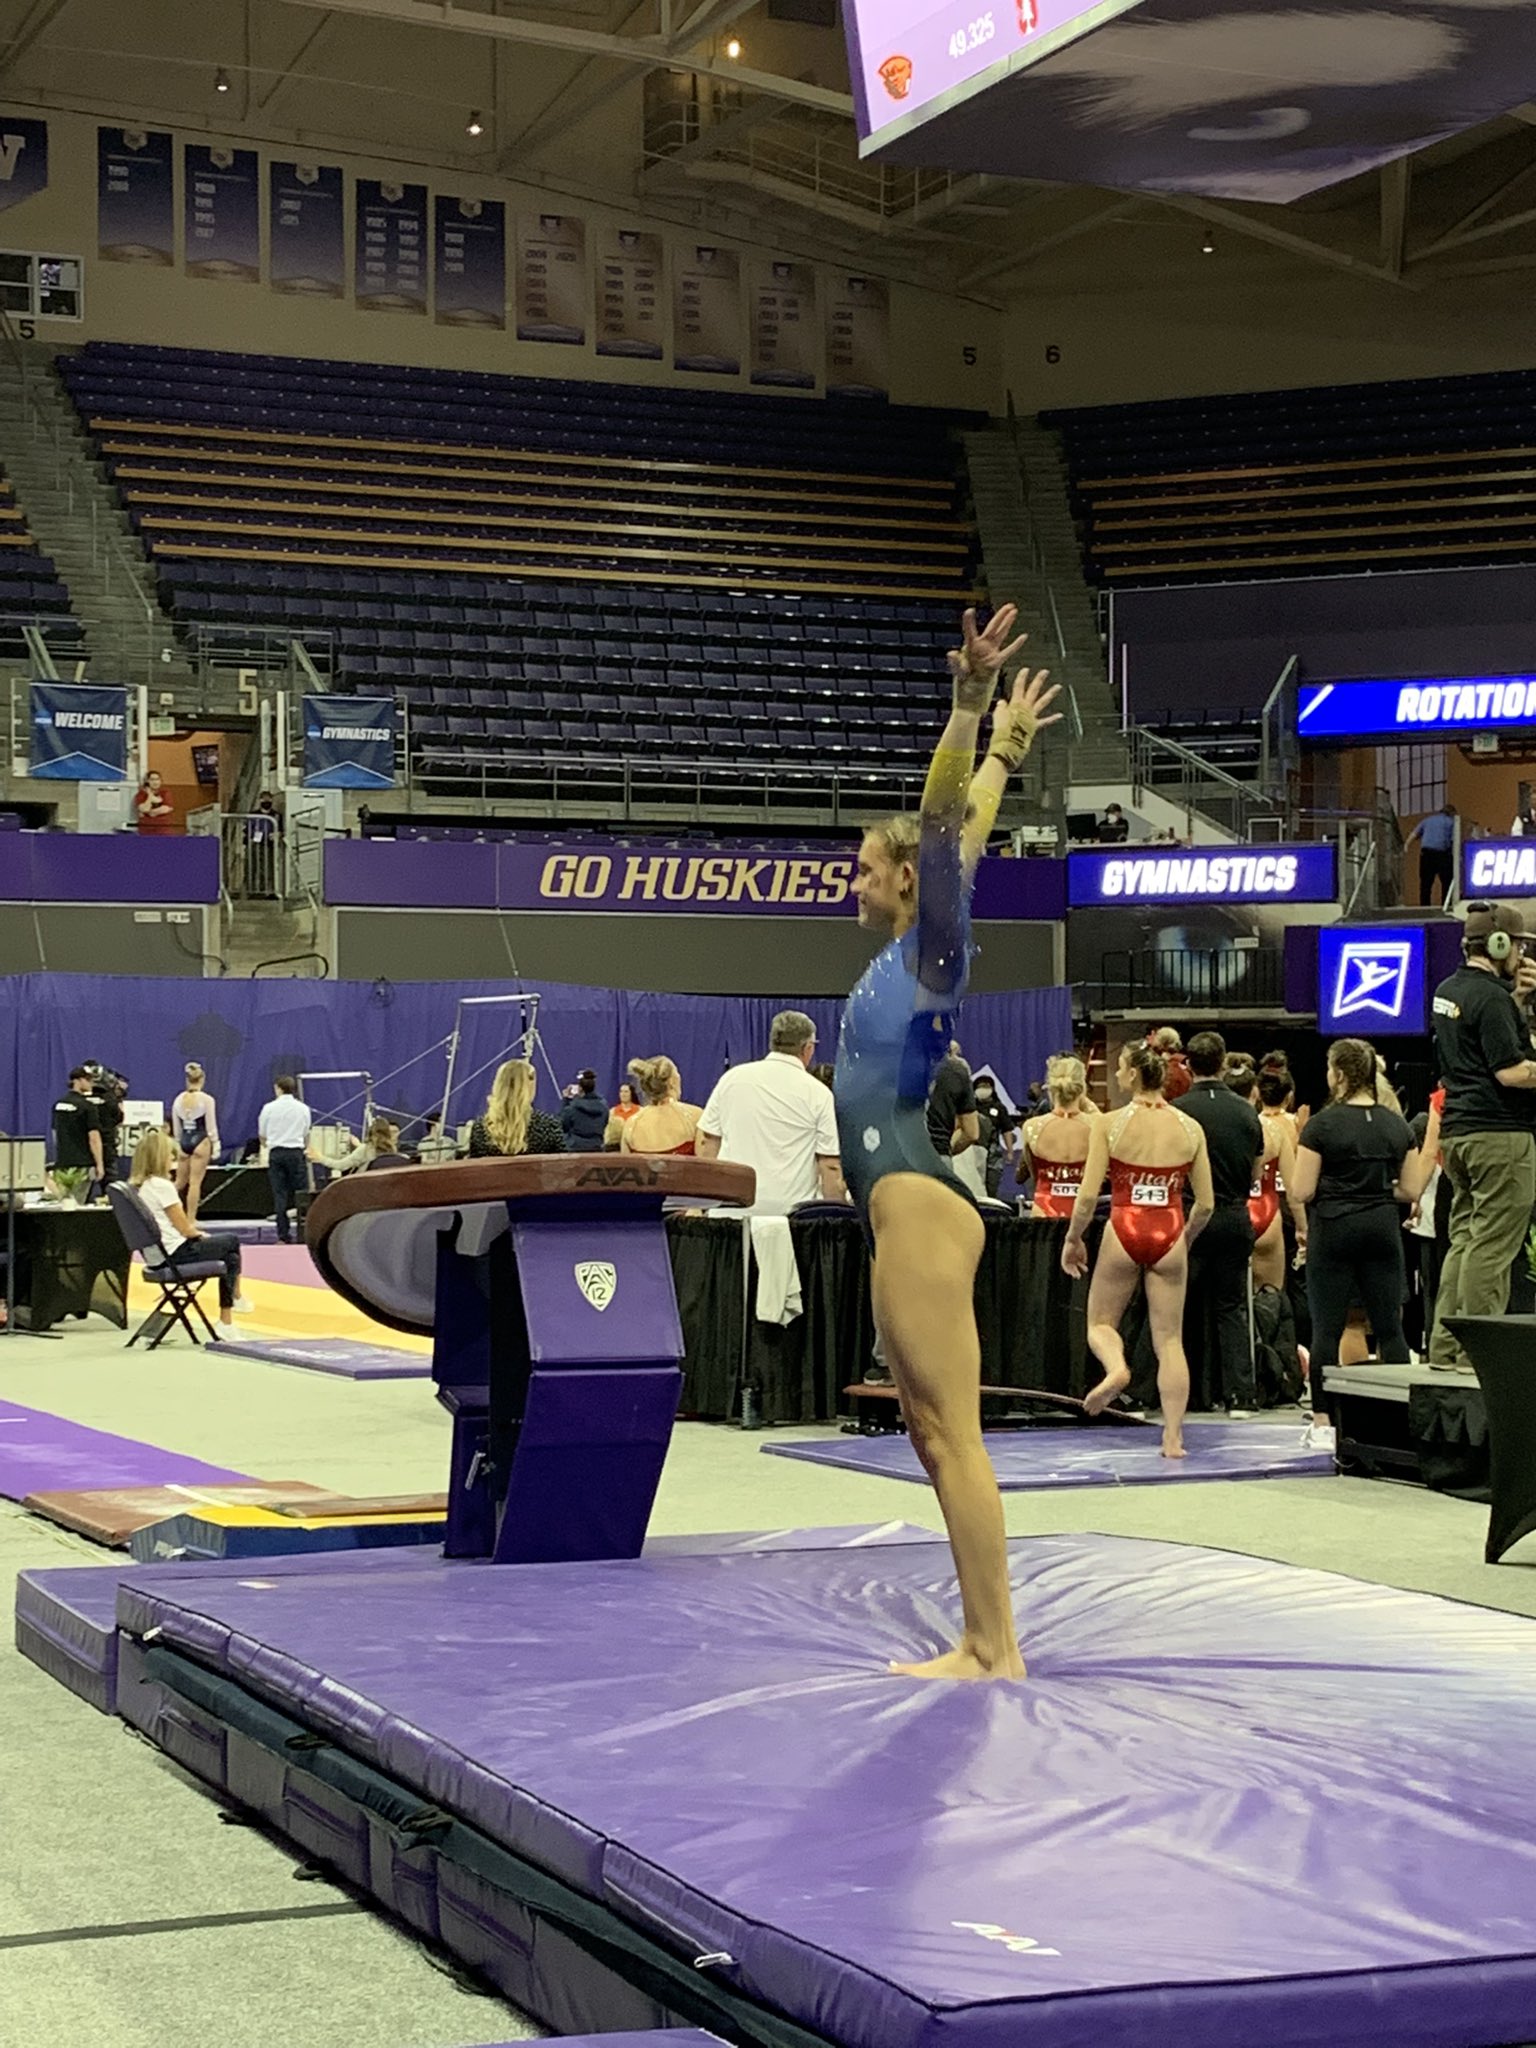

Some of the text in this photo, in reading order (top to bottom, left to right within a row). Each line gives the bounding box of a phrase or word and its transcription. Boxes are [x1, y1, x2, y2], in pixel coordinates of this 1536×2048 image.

[948, 12, 995, 58] 49.325
[19, 319, 35, 340] 5
[962, 346, 977, 366] 5
[1045, 344, 1061, 364] 6
[238, 667, 258, 716] 5
[55, 711, 124, 730] WELCOME
[322, 726, 391, 741] GYMNASTICS
[540, 854, 852, 903] GO HUSKIES
[1101, 856, 1298, 896] GYMNASTICS
[1133, 1188, 1166, 1202] 513
[592, 1286, 607, 1301] 12
